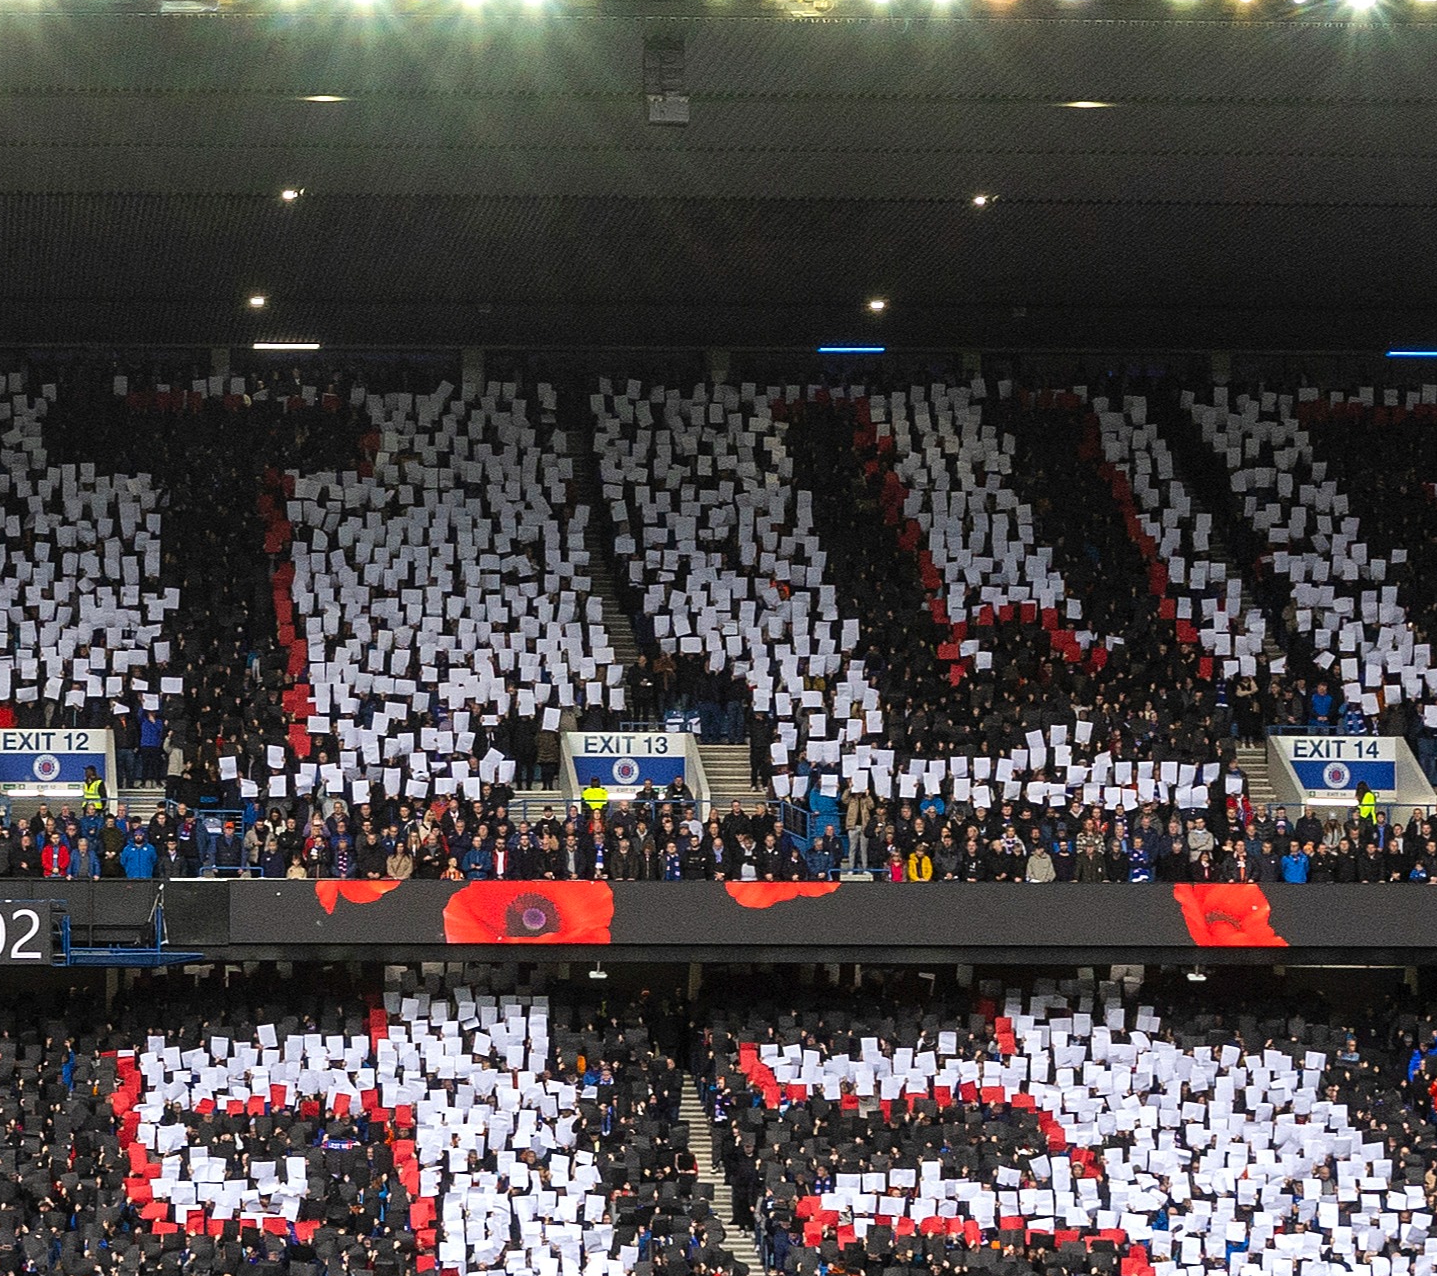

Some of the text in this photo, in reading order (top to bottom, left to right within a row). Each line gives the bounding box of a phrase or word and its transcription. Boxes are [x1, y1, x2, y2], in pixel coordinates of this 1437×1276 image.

[3, 732, 90, 750] EXIT 12
[584, 736, 669, 754] EXIT 13
[1293, 739, 1379, 758] EXIT 14
